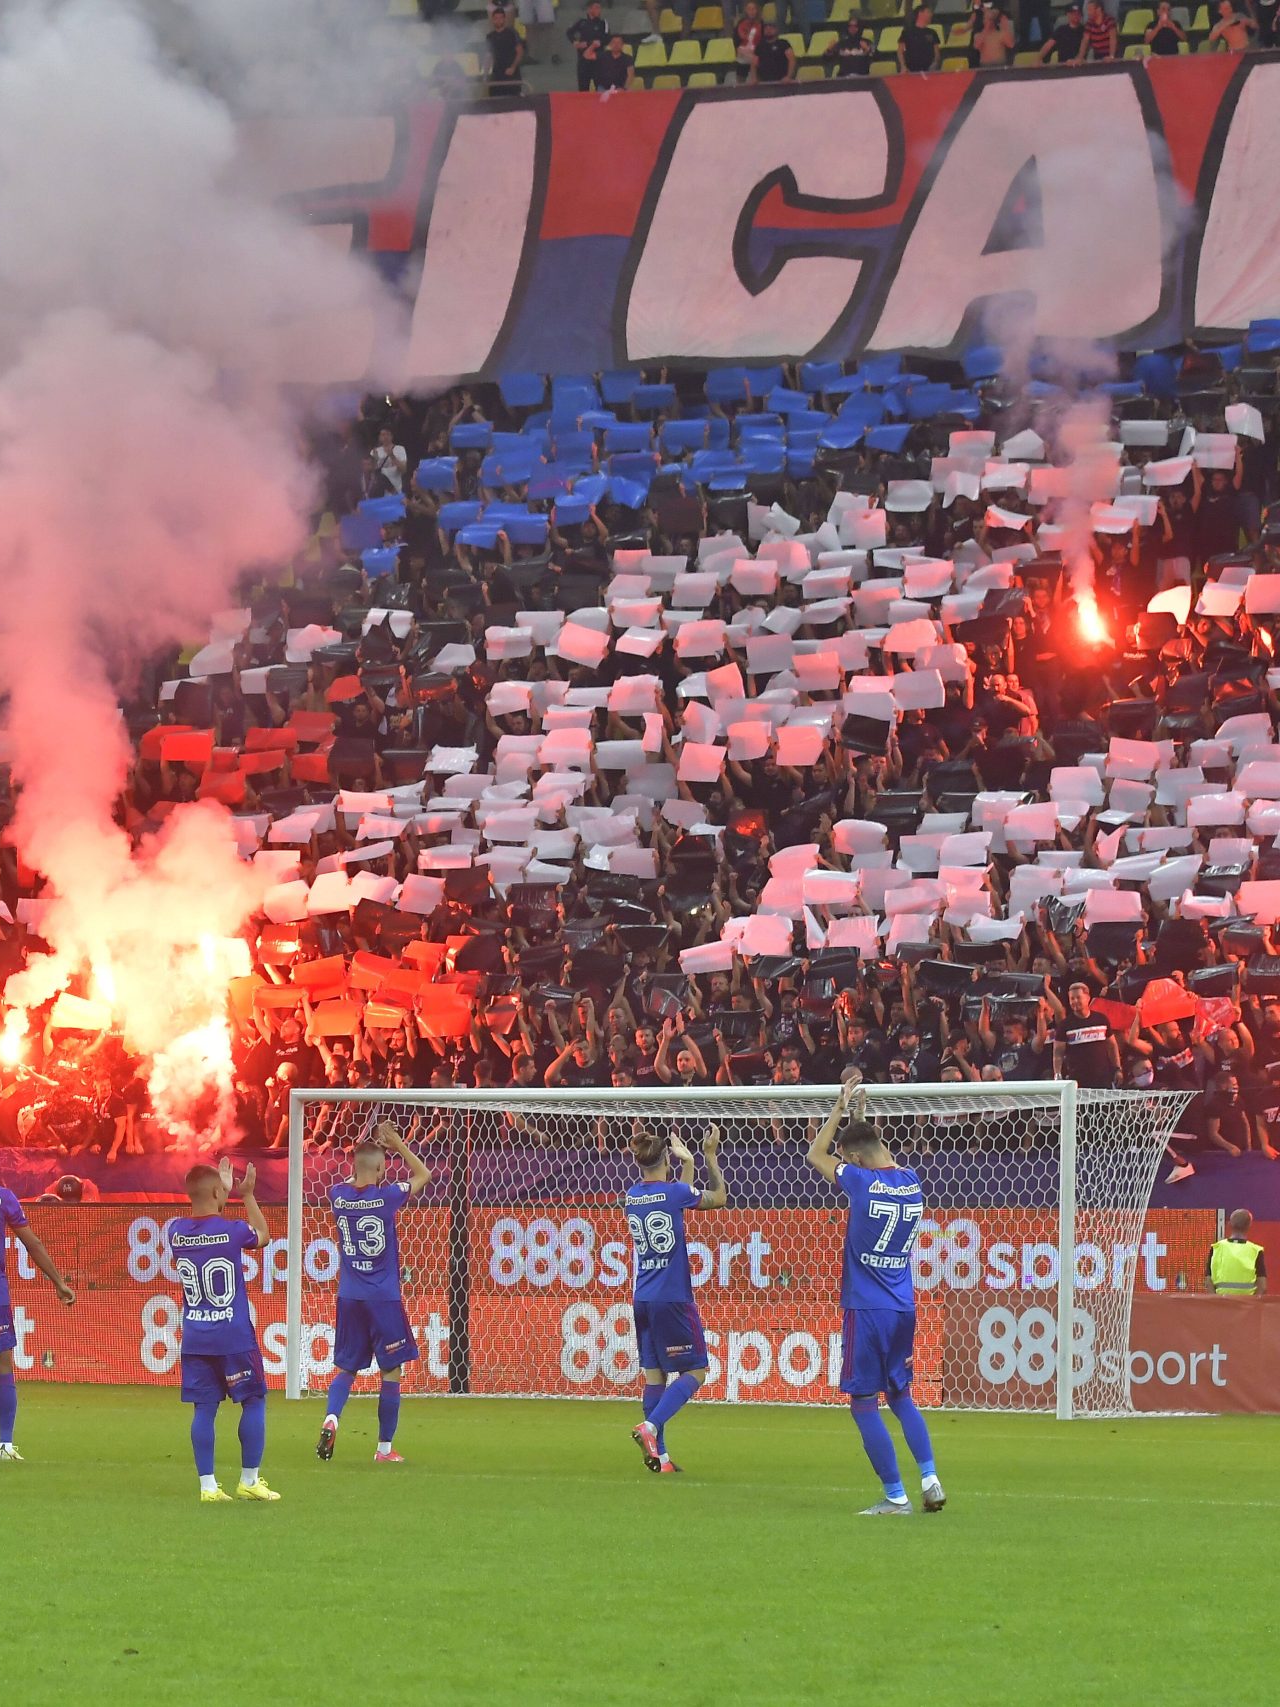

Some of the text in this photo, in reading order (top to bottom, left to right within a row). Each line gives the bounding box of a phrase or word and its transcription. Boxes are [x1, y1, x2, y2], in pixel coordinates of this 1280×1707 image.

[340, 1198, 384, 1210] Porotherm
[179, 1234, 229, 1245] Porotherm
[337, 1215, 386, 1257] 13
[627, 1210, 676, 1254] 98
[868, 1200, 923, 1253] 77
[175, 1256, 236, 1308] 90
[978, 1306, 1227, 1400] 888sport
